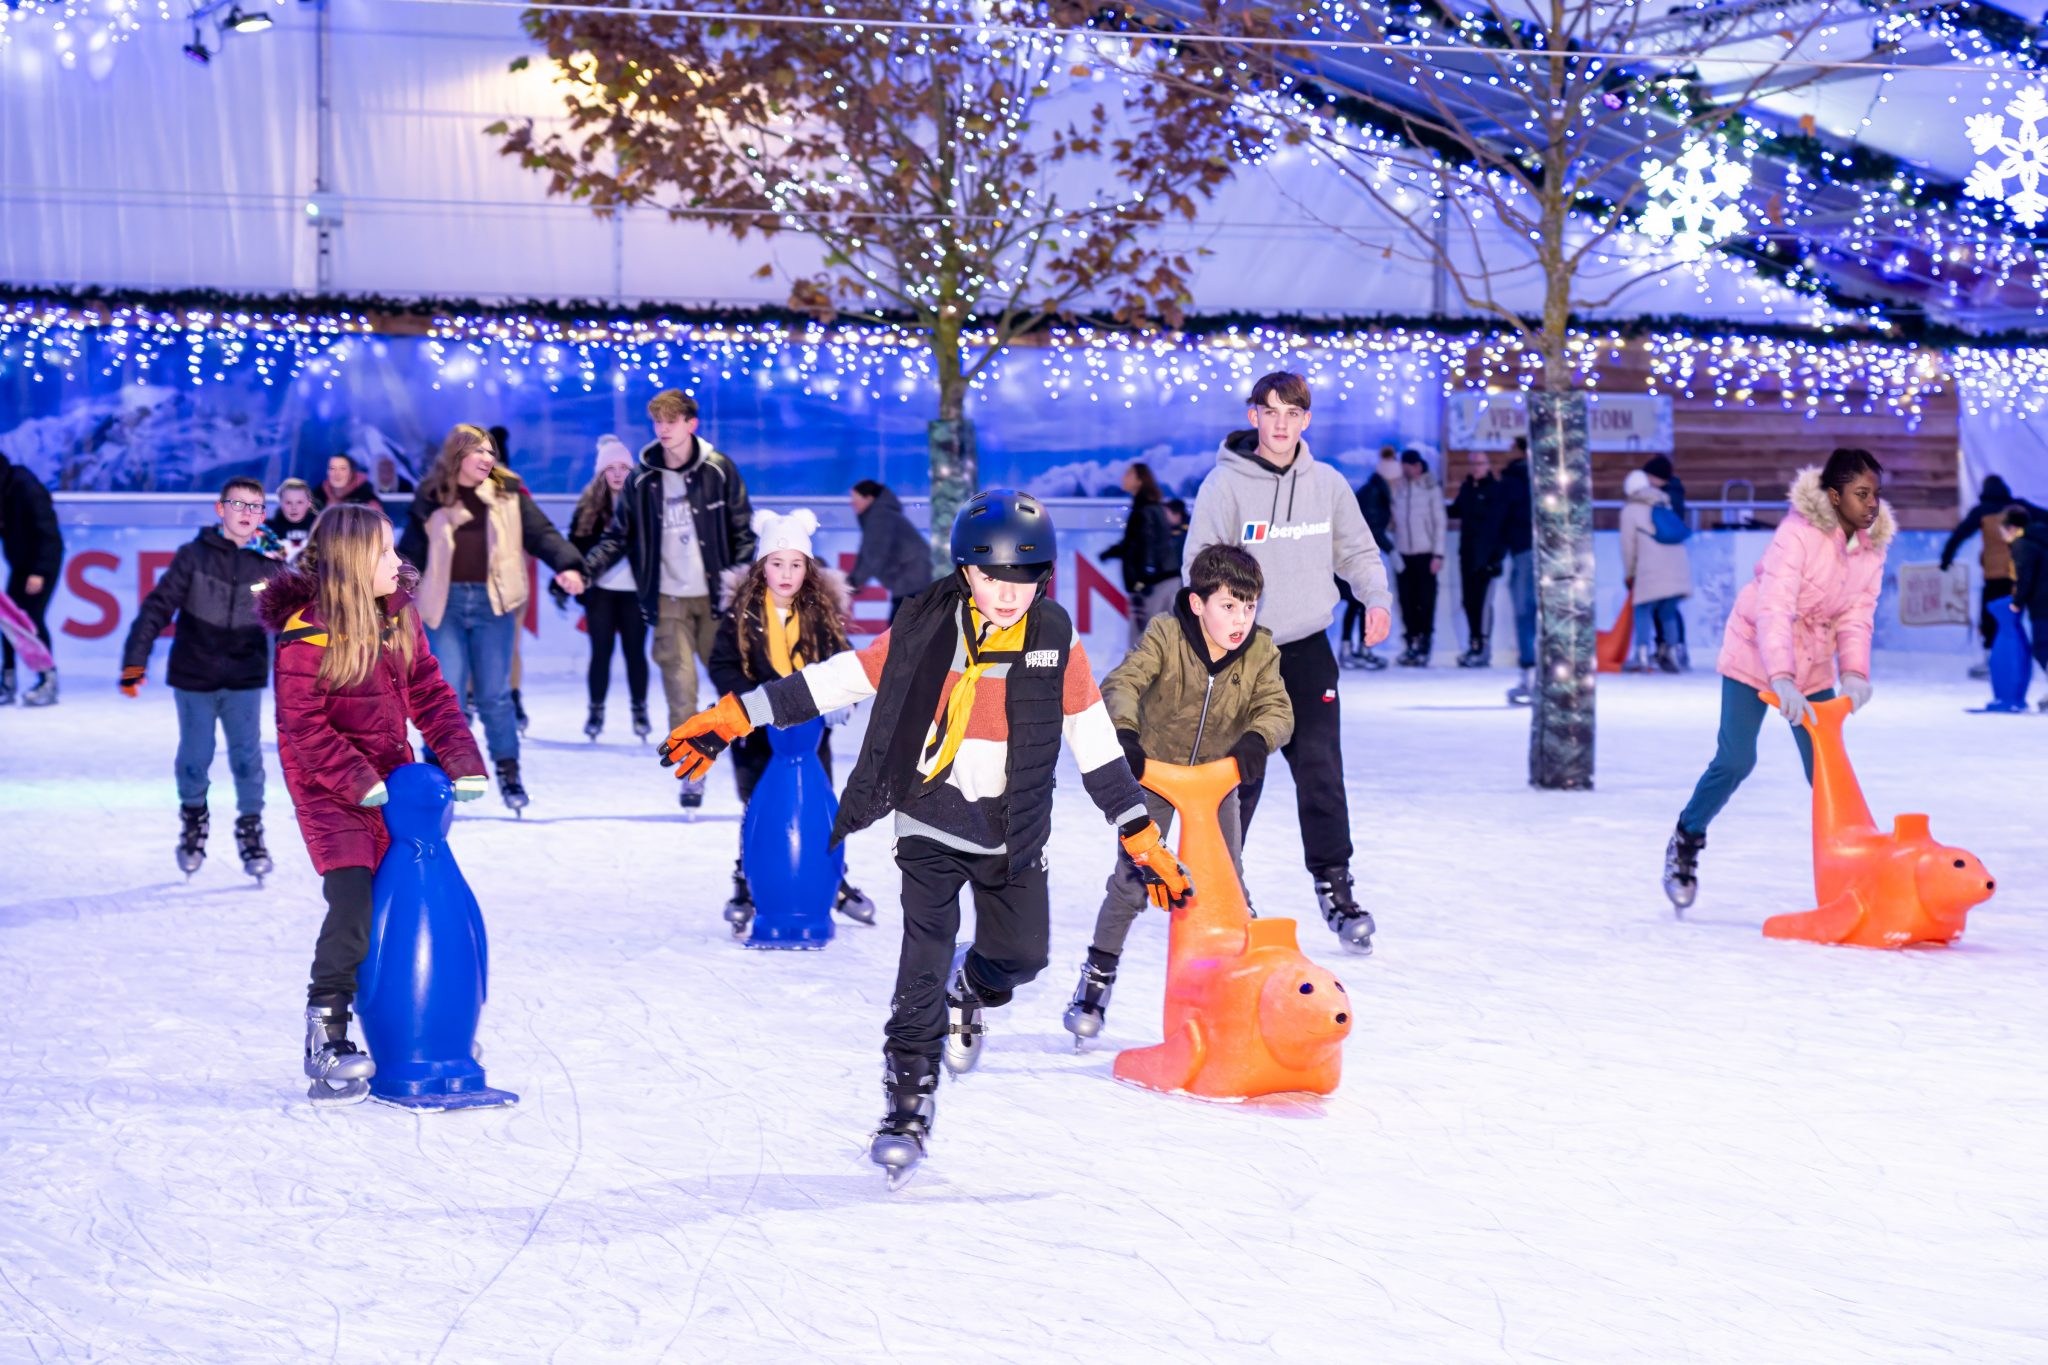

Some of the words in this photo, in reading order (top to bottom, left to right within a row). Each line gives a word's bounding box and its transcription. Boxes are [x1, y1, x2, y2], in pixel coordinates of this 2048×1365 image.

[1269, 523, 1330, 540] berghaus
[1026, 650, 1058, 660] UNSTO
[1026, 659, 1058, 668] PPABLE
